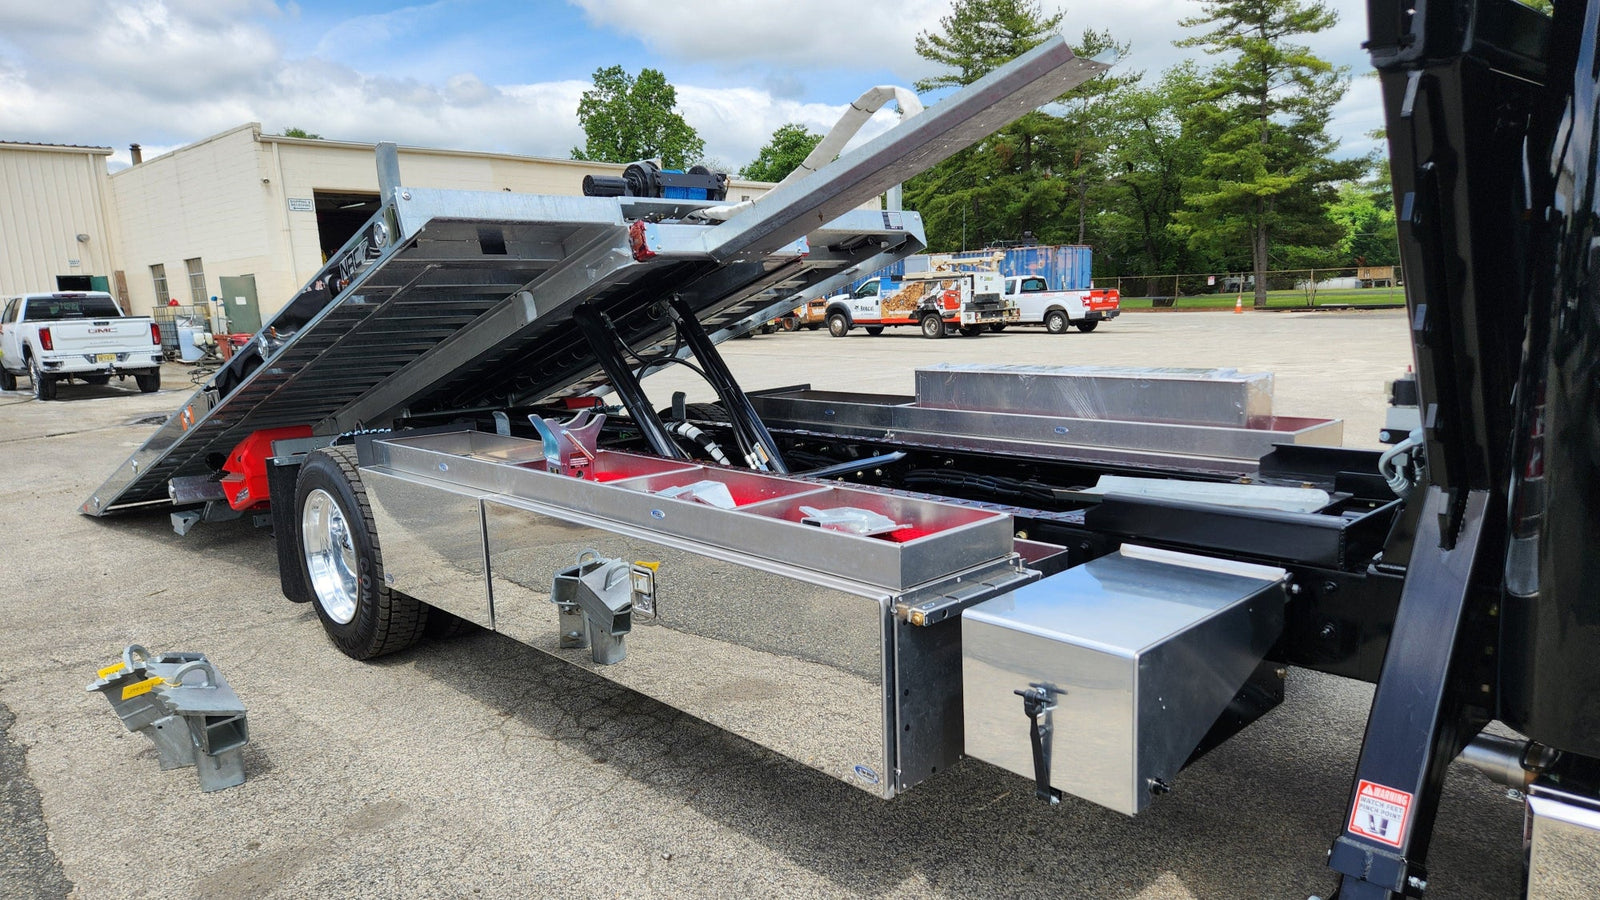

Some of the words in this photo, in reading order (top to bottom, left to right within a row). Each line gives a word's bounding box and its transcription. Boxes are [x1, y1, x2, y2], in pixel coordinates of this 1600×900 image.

[1374, 786, 1408, 805] WARNING
[1359, 803, 1379, 813] PINCH
[1381, 810, 1401, 820] POINT
[1361, 796, 1384, 808] WATCH
[1386, 804, 1403, 814] FEET
